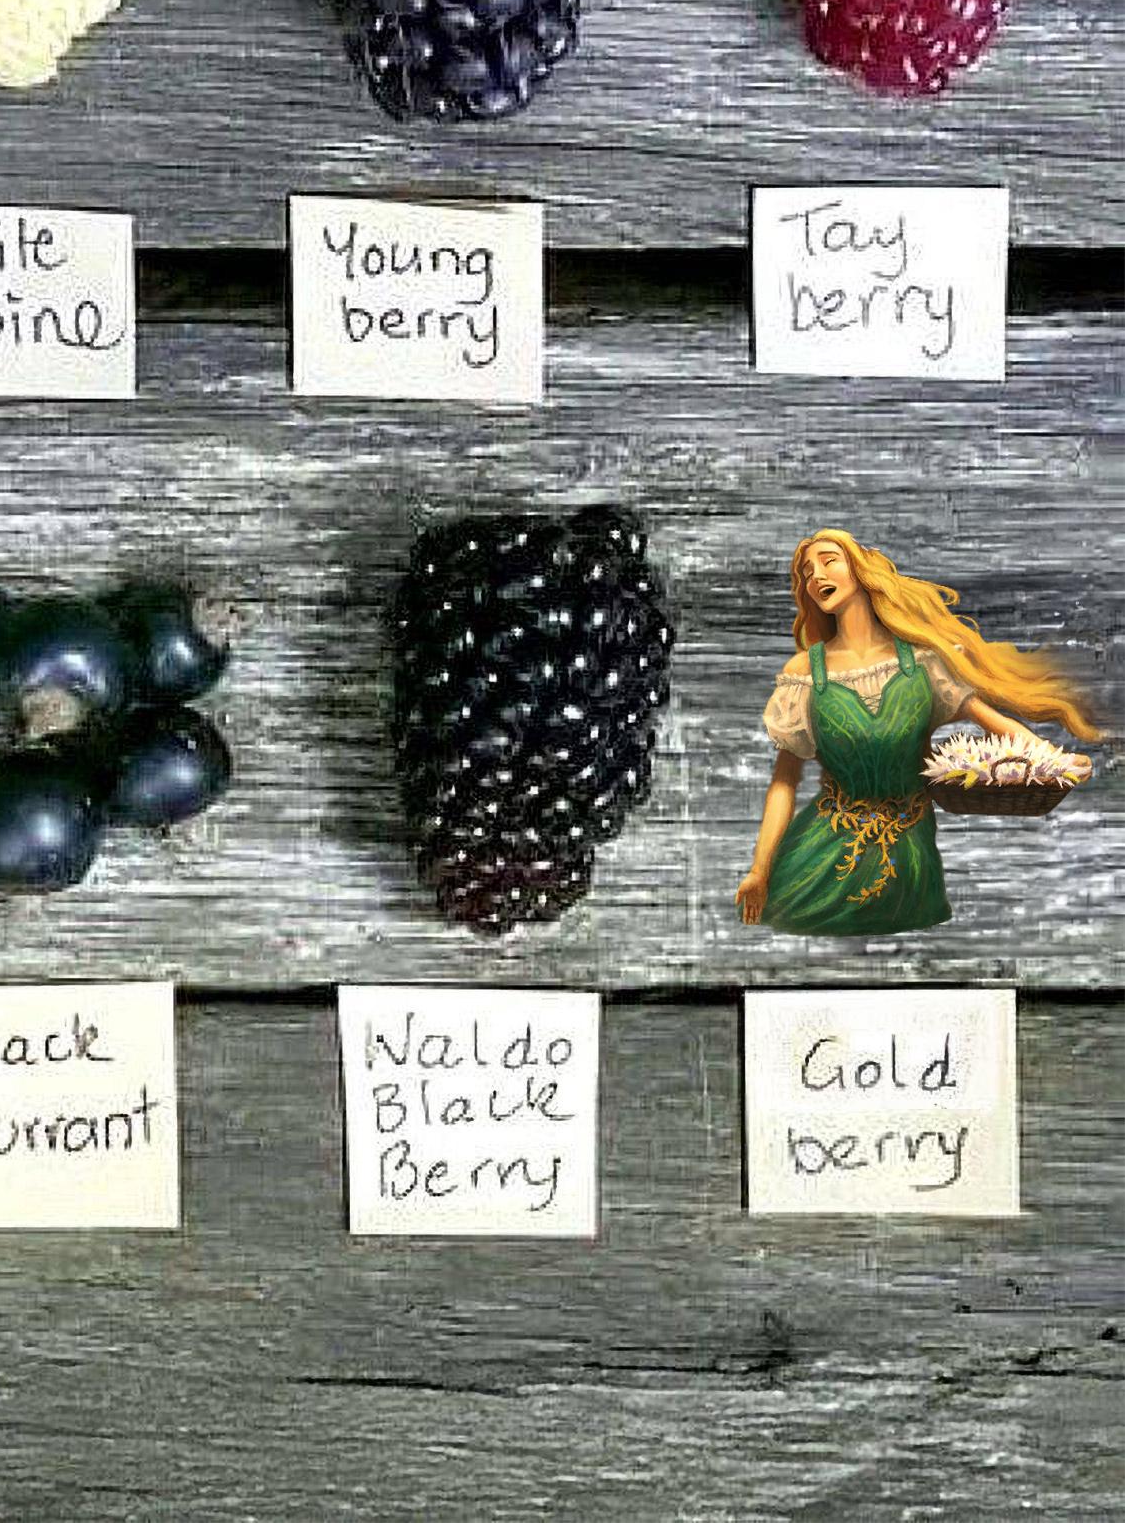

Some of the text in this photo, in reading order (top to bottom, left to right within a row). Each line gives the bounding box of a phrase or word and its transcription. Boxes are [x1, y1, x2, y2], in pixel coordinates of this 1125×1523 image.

[323, 221, 494, 305] Young
[780, 200, 907, 281] Tay
[341, 293, 498, 369] berry
[790, 273, 953, 360] berry
[802, 1033, 956, 1091] Gold
[373, 1077, 575, 1133] Black
[380, 1140, 561, 1212] Berry
[787, 1127, 968, 1192] berry
